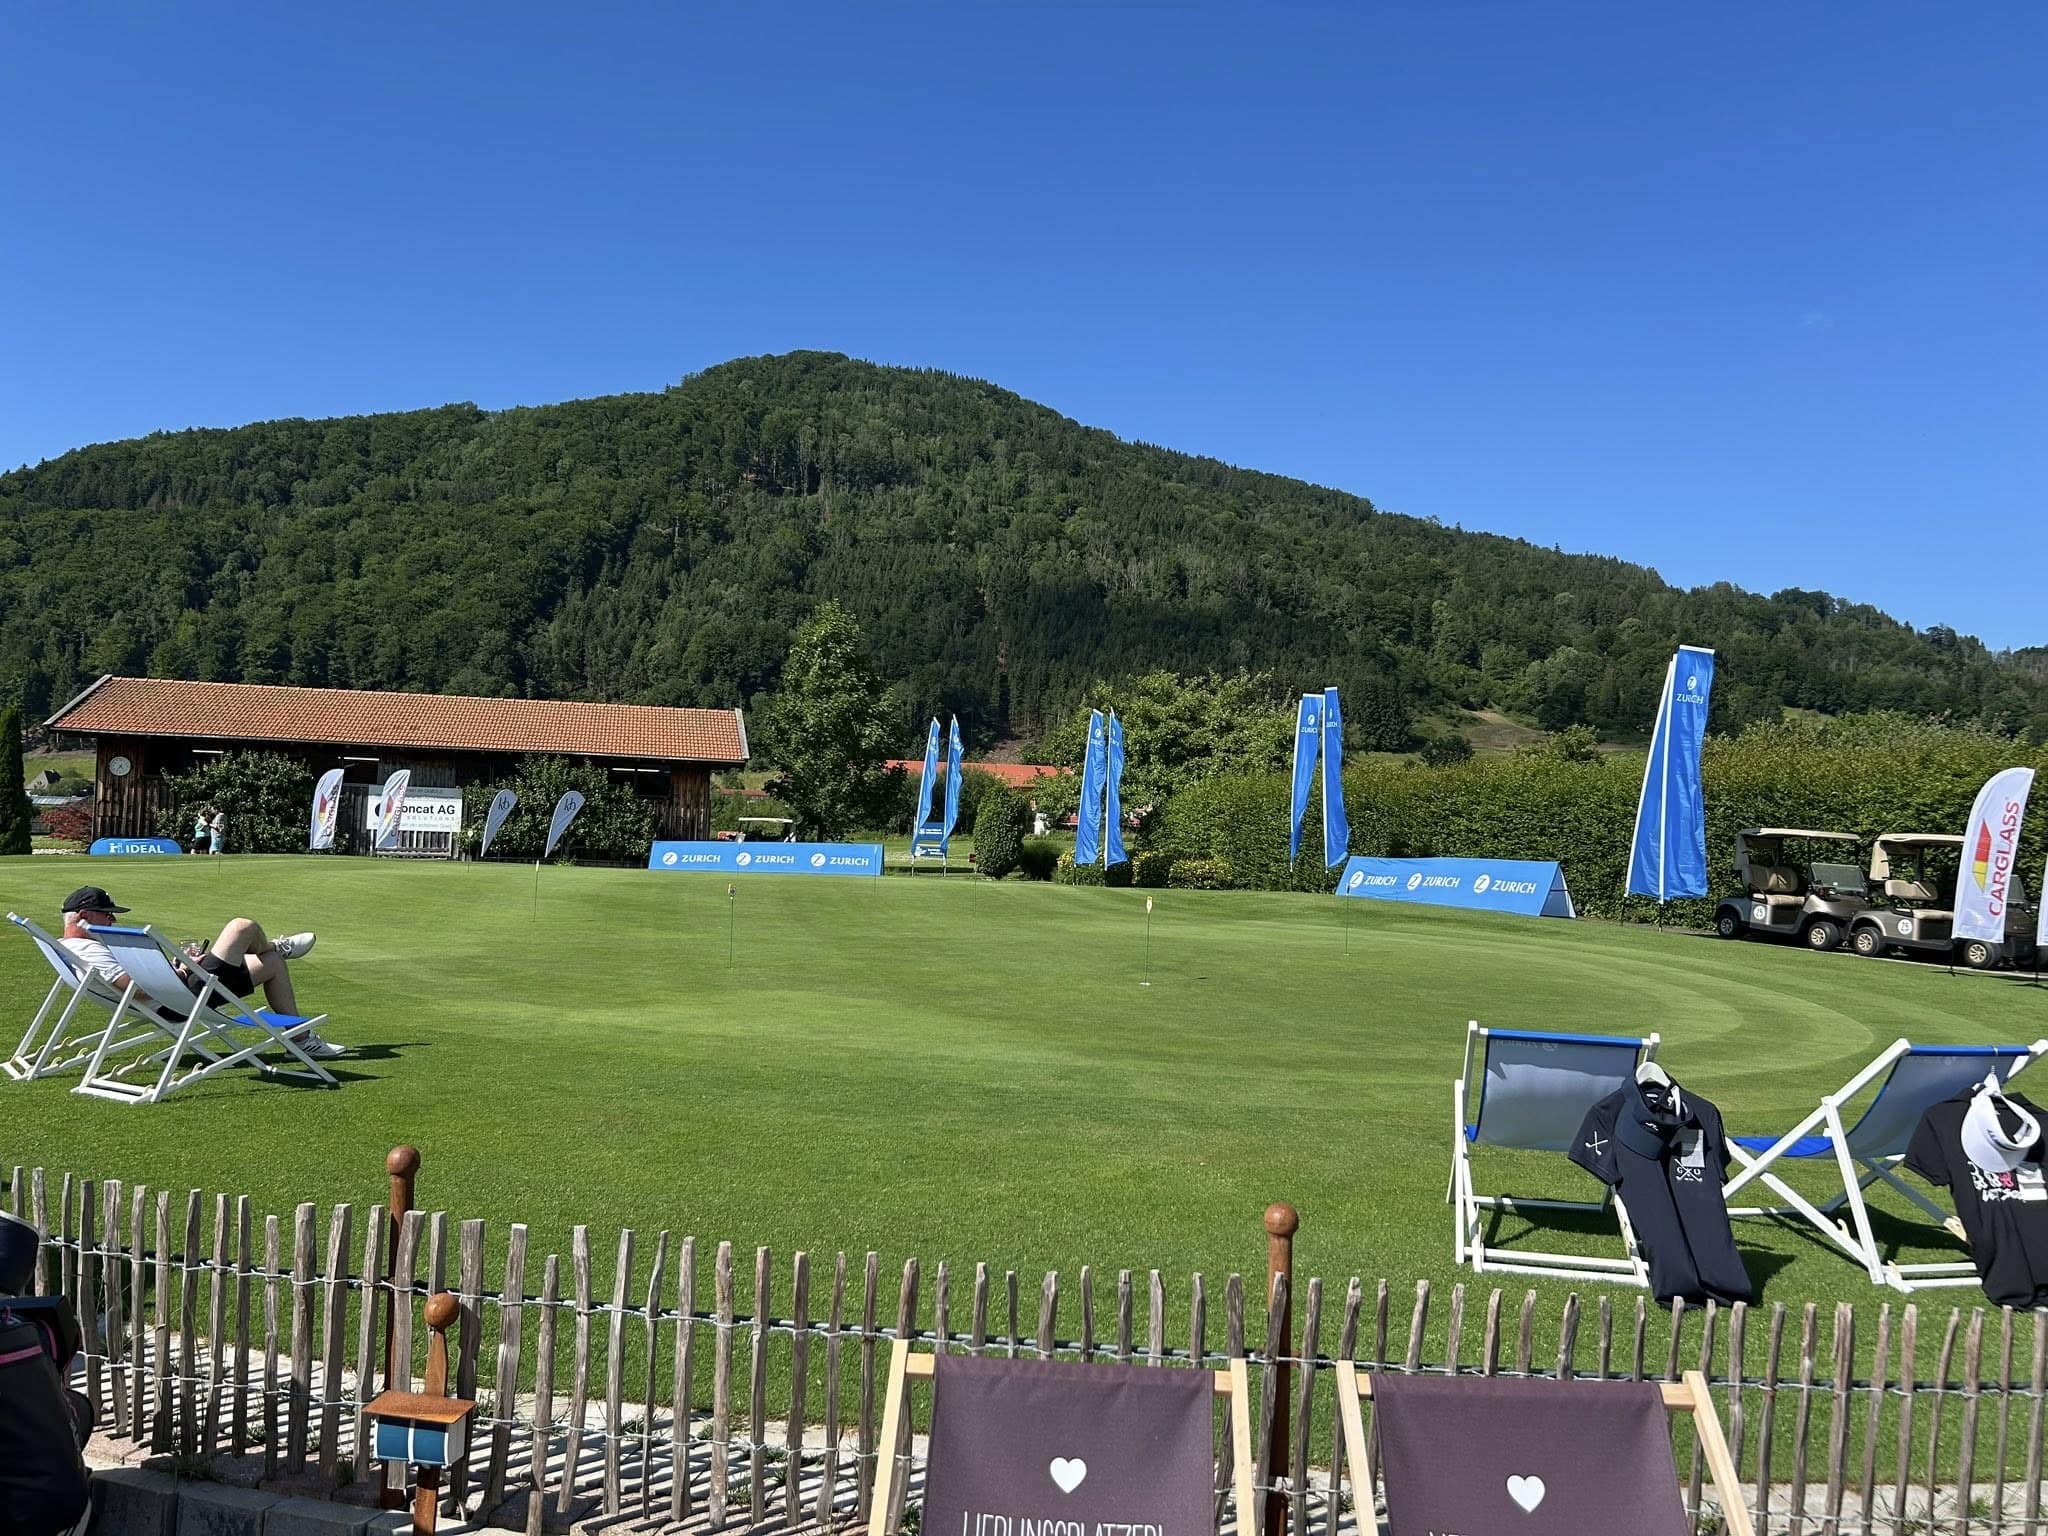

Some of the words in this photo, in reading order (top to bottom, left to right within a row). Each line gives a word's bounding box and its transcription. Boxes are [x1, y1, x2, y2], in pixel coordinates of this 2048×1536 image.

[401, 804, 434, 814] oncat
[437, 804, 455, 815] AG
[126, 844, 164, 854] IDEAL
[681, 854, 721, 863] ZURICH
[755, 855, 795, 864] ZURICH
[829, 856, 870, 866] ZURICH
[1988, 801, 2020, 917] CARGLASS
[1364, 875, 1398, 887] ZURICH
[1422, 876, 1461, 888] ZURICH
[1491, 879, 1537, 894] ZURICH
